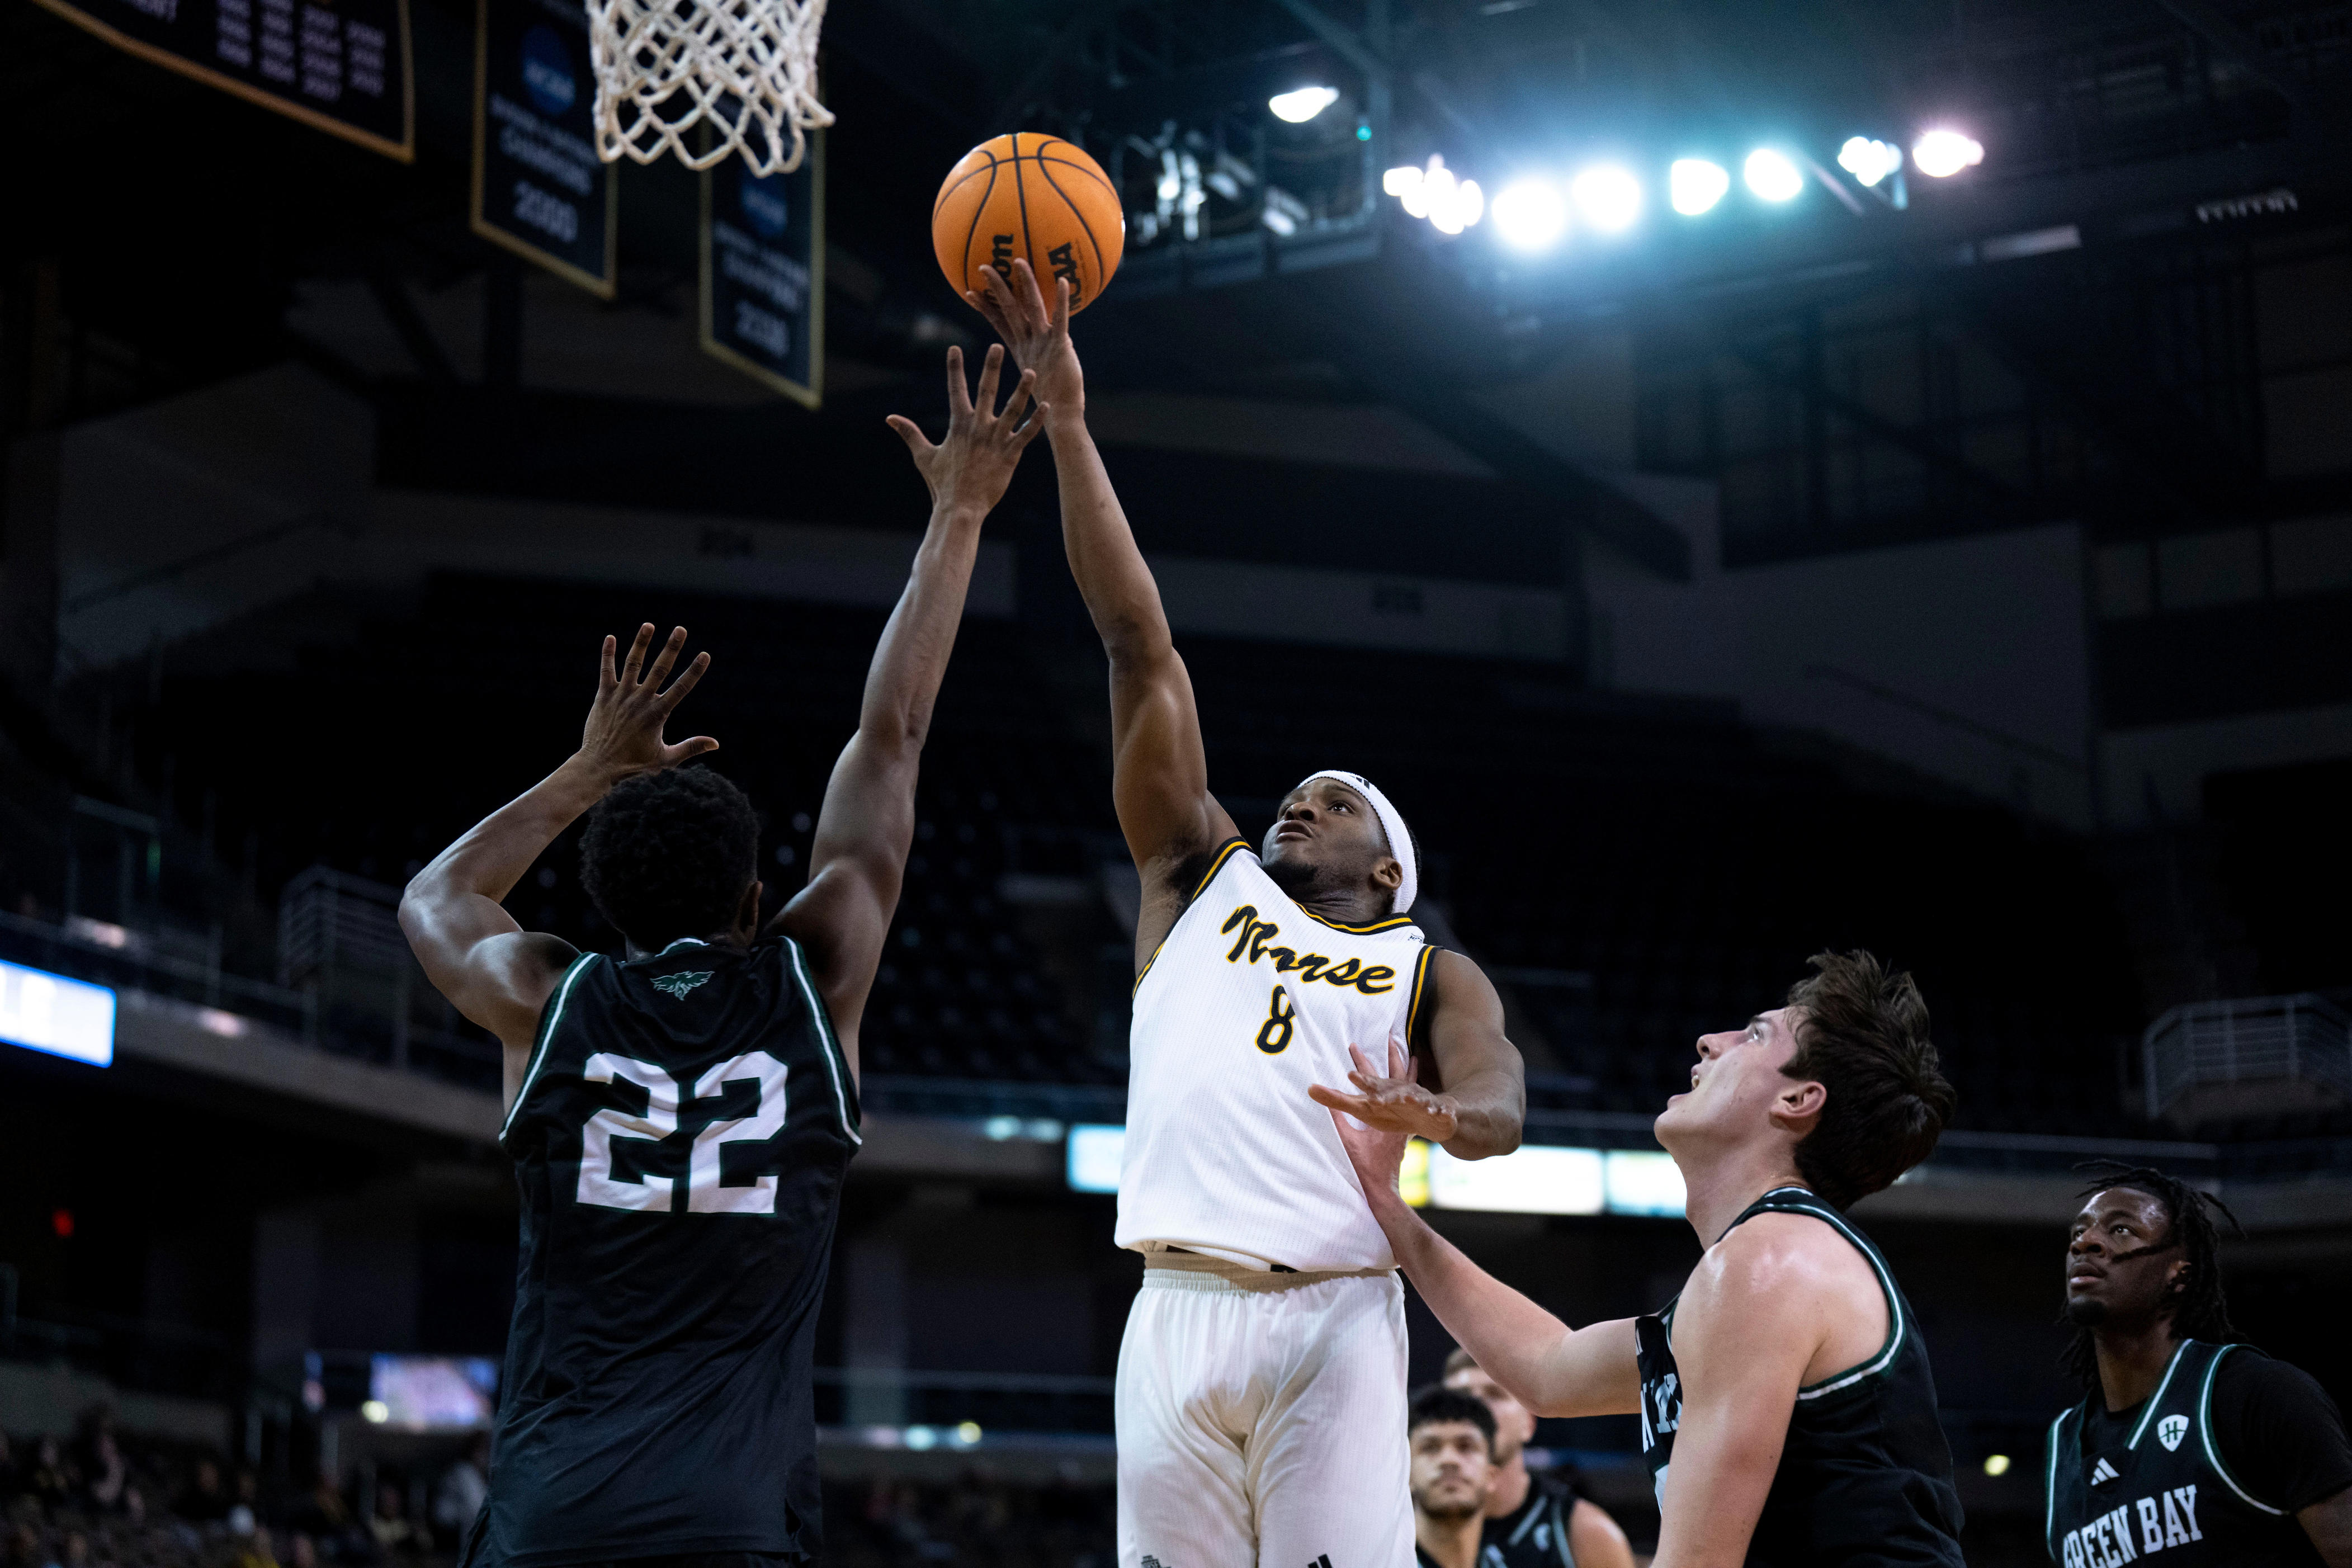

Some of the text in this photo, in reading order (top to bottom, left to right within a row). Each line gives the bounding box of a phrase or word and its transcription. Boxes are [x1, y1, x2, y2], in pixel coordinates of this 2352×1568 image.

[1221, 904, 1396, 995] Norse
[1255, 984, 1296, 1055] 8
[575, 1050, 789, 1214] 22
[2063, 1484, 2203, 1568] GREEN BAY
